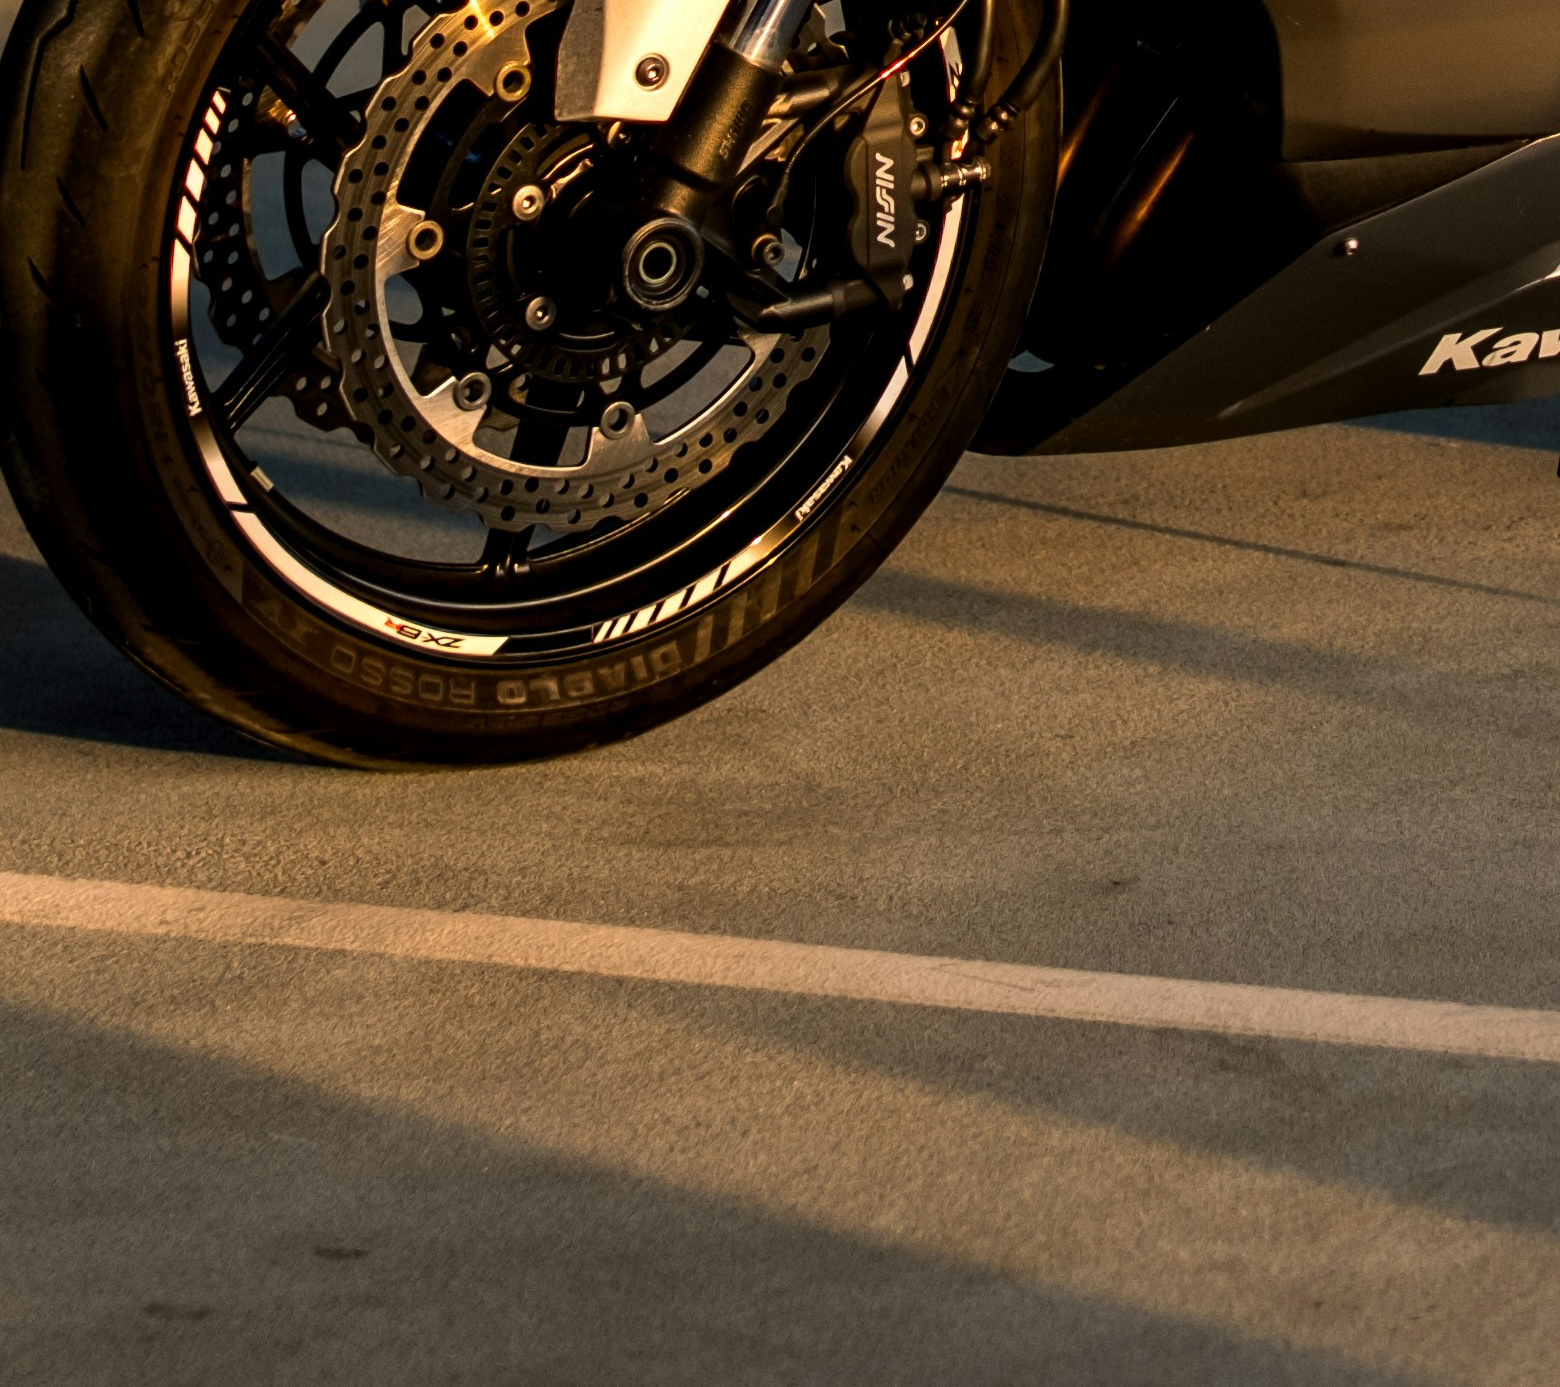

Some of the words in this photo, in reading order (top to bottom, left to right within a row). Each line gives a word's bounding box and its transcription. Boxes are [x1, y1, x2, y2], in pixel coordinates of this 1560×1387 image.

[174, 338, 203, 417] Kawasaki
[793, 453, 853, 523] Kawasaki
[384, 616, 466, 649] ZX-6R
[326, 641, 478, 705] ROSSO
[492, 639, 683, 708] DIABLO
